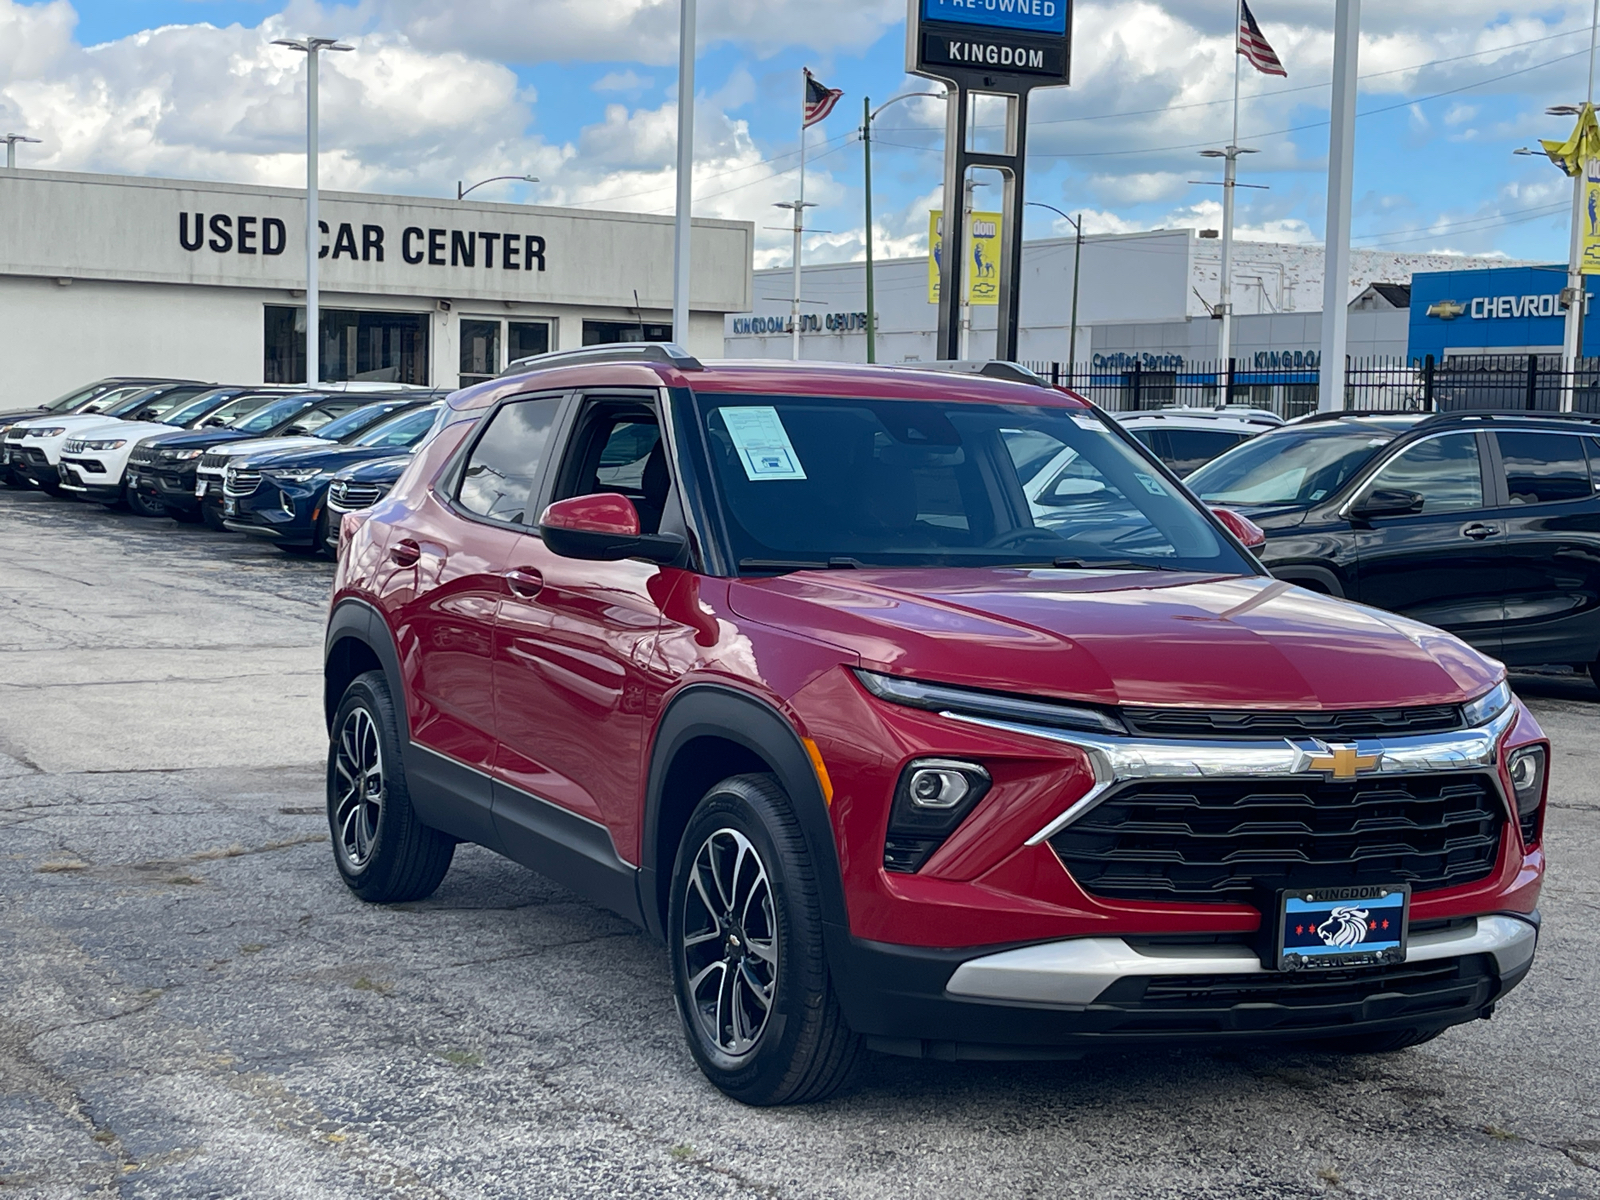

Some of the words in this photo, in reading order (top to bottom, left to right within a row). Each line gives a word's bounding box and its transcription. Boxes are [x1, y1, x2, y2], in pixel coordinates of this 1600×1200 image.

[949, 41, 1044, 69] KINGDOM
[973, 219, 996, 237] dom
[179, 212, 287, 256] USED
[318, 219, 385, 262] CAR
[402, 226, 546, 272] CENTER
[1471, 293, 1595, 319] CHEVROLT
[733, 316, 784, 335] KINGDOM
[786, 314, 820, 333] TO
[825, 312, 878, 331] CENTE
[1092, 352, 1139, 368] Certified
[1142, 352, 1183, 368] Service
[1254, 350, 1321, 368] KINGDO
[1314, 887, 1380, 900] KINGDOM
